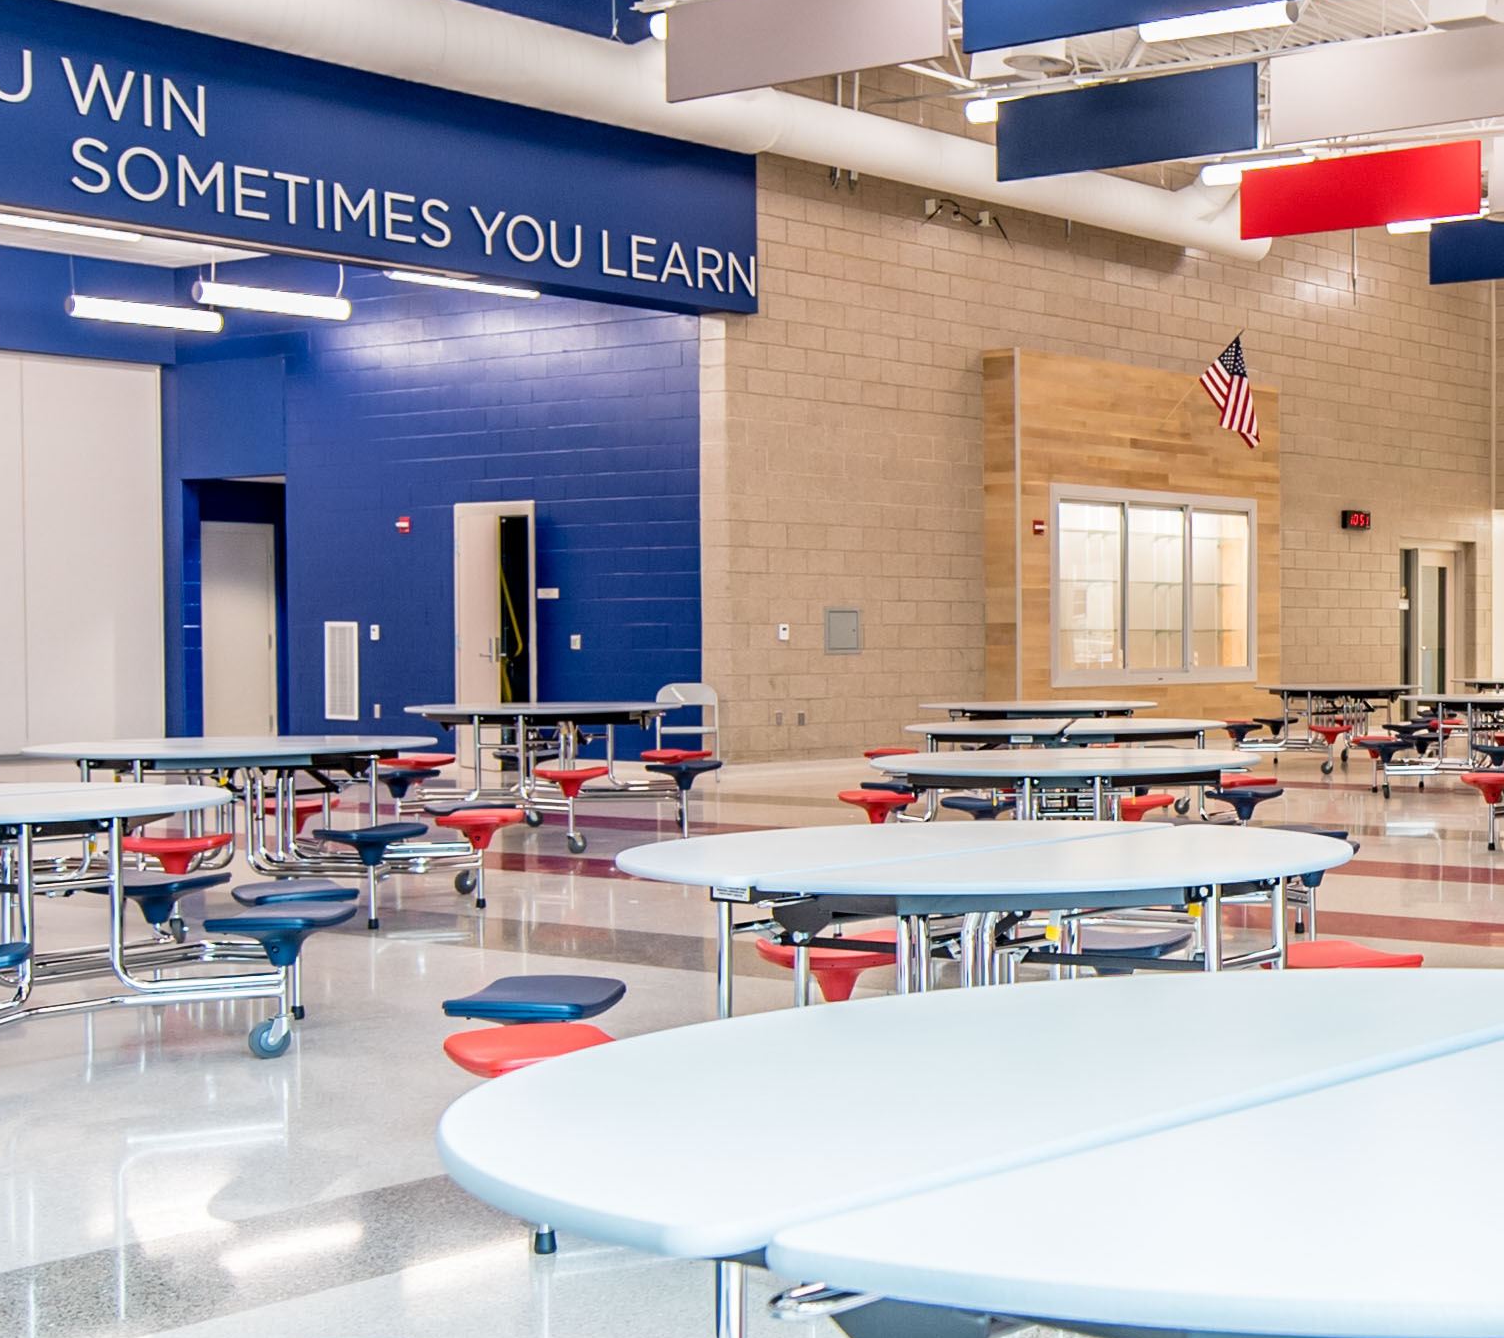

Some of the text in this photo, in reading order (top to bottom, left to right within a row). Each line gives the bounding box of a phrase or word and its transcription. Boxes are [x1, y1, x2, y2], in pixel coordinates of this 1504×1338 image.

[60, 56, 207, 138] WIN
[71, 136, 757, 298] SOMETIMES YOU LEARN
